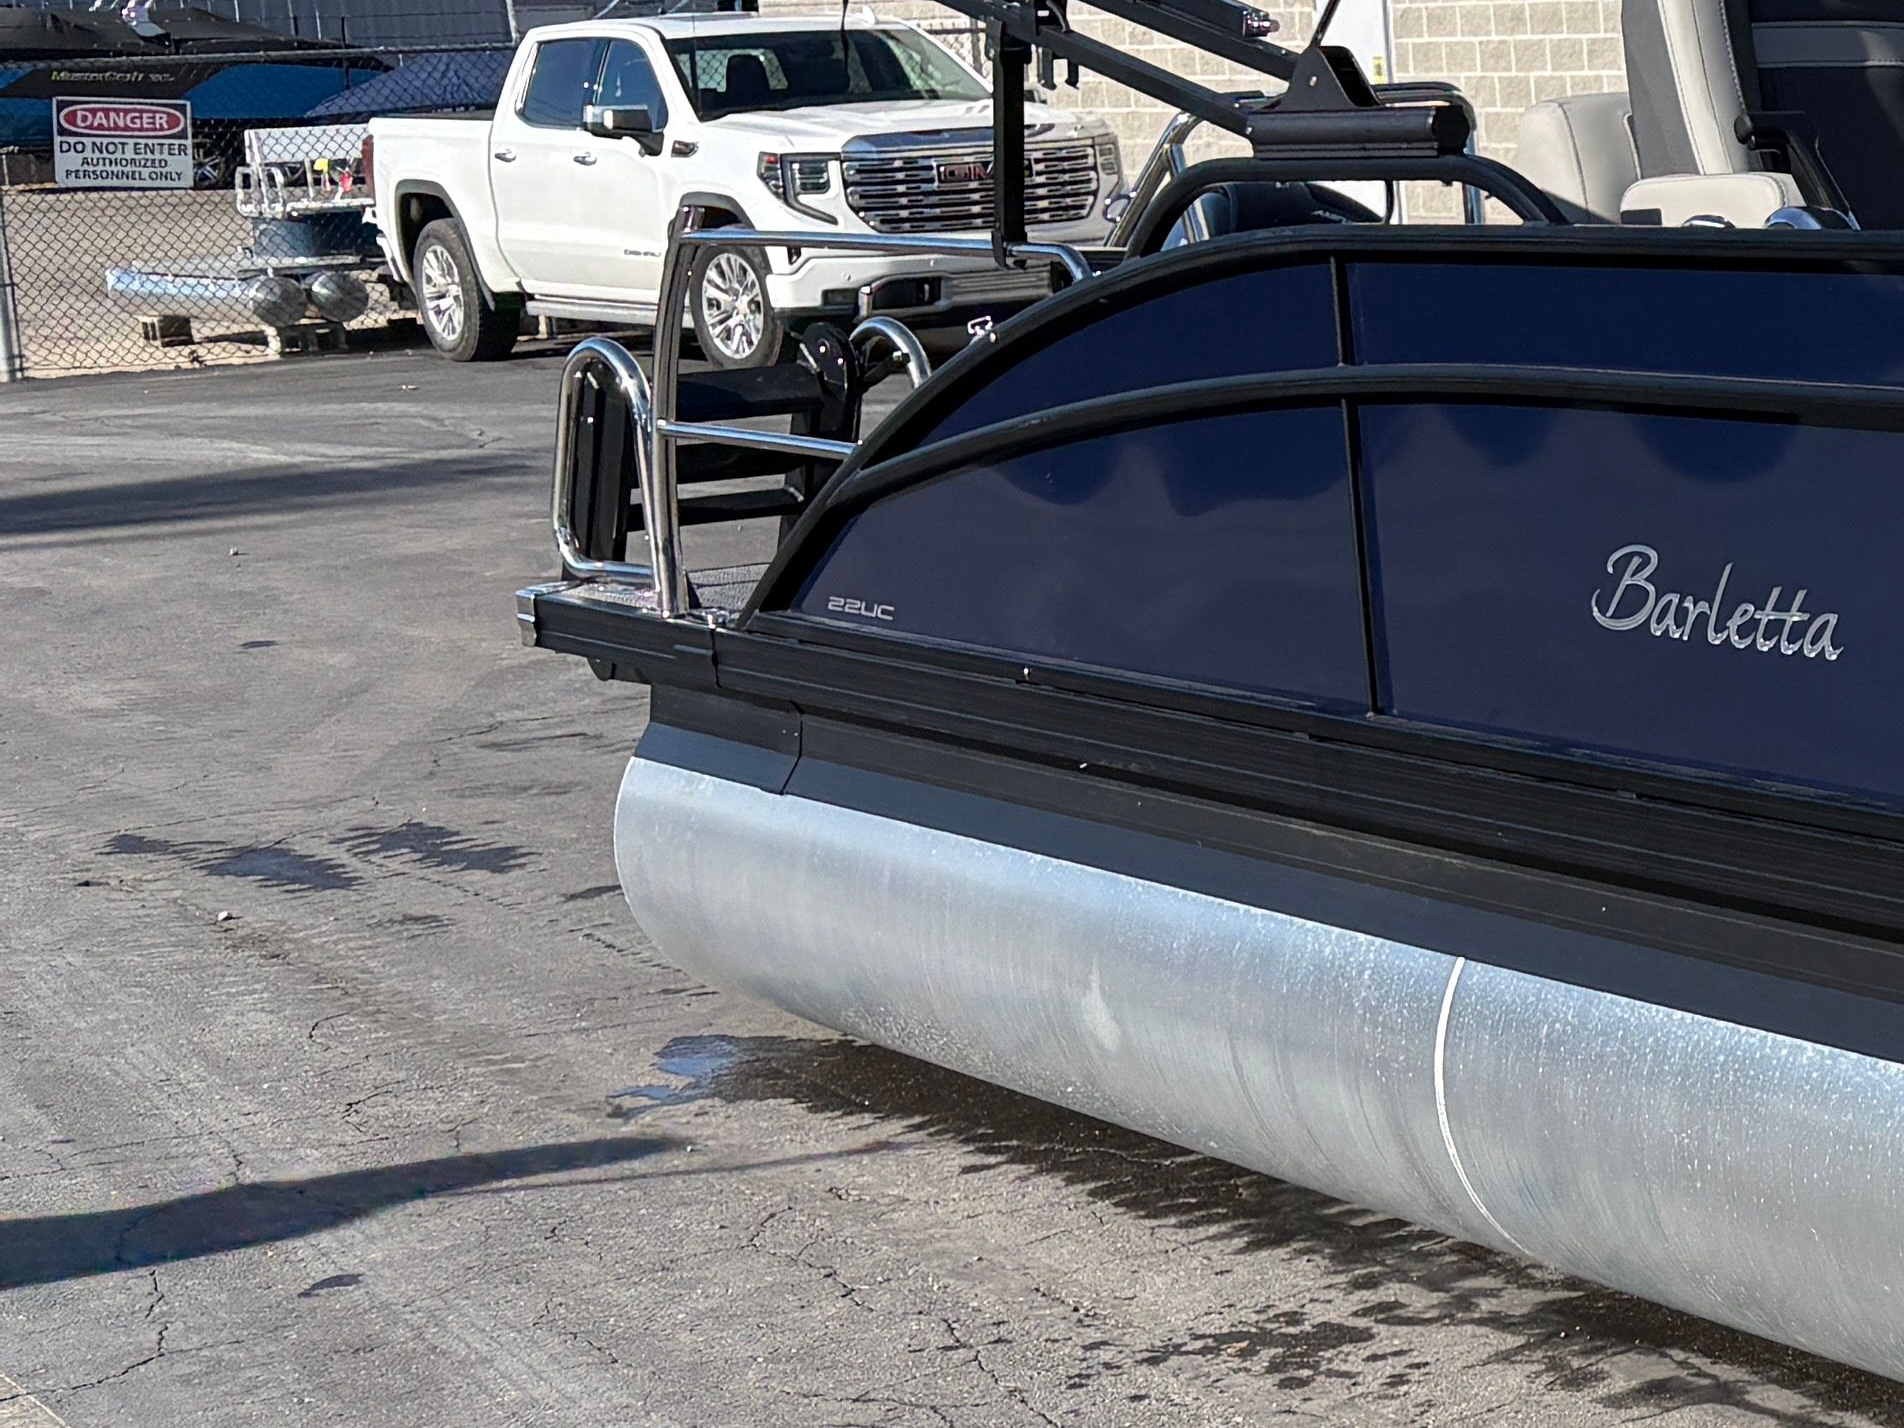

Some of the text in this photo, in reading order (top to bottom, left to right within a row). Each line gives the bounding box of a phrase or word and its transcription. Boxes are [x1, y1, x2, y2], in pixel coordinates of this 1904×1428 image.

[76, 110, 169, 129] DANGER
[60, 140, 188, 156] DO NOT ENTER
[81, 157, 168, 169] AUTHORIZED
[65, 169, 183, 182] PERSONNEL ONLY
[828, 596, 895, 621] 22UC
[1591, 544, 1844, 661] Barletta
